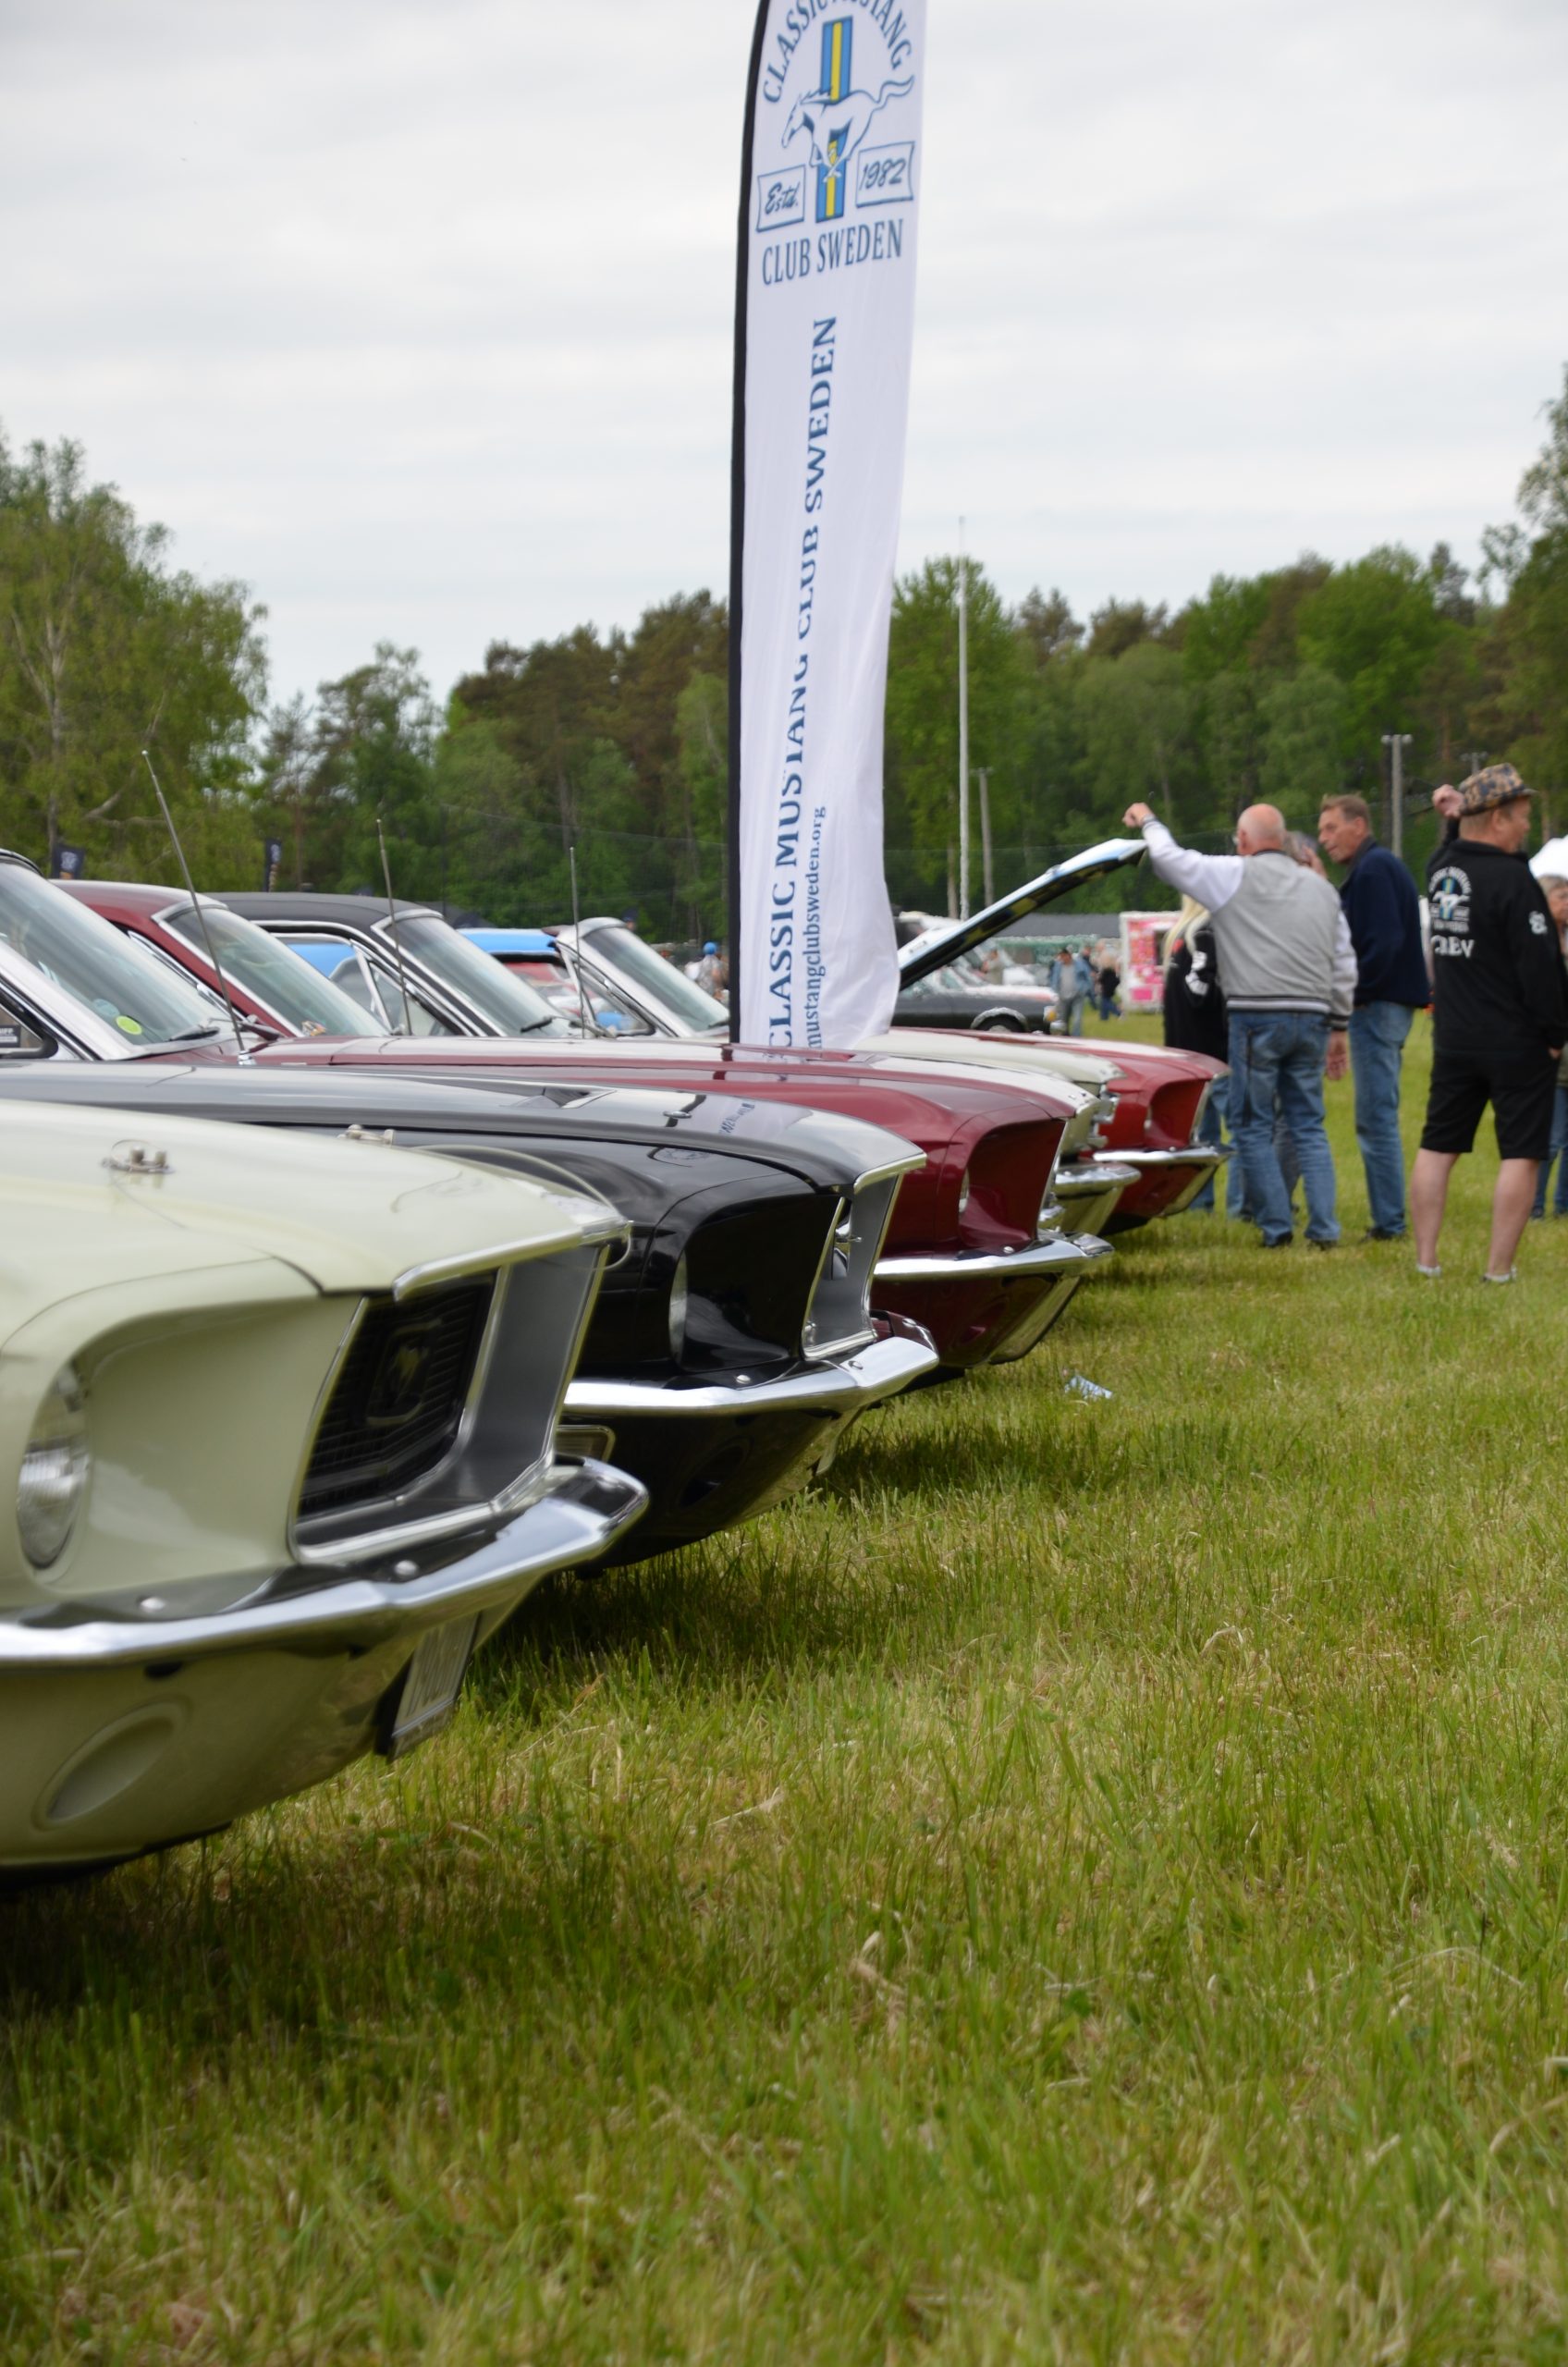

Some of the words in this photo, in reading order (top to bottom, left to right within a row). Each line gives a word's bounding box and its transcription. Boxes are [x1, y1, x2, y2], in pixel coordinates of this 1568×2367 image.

[859, 158, 907, 191] 1982
[762, 237, 812, 287] CLUB
[816, 218, 903, 274] SWEDEN
[804, 316, 837, 514] SWEDEN
[798, 524, 819, 641] CLUB
[769, 880, 795, 1047] CLASSIC
